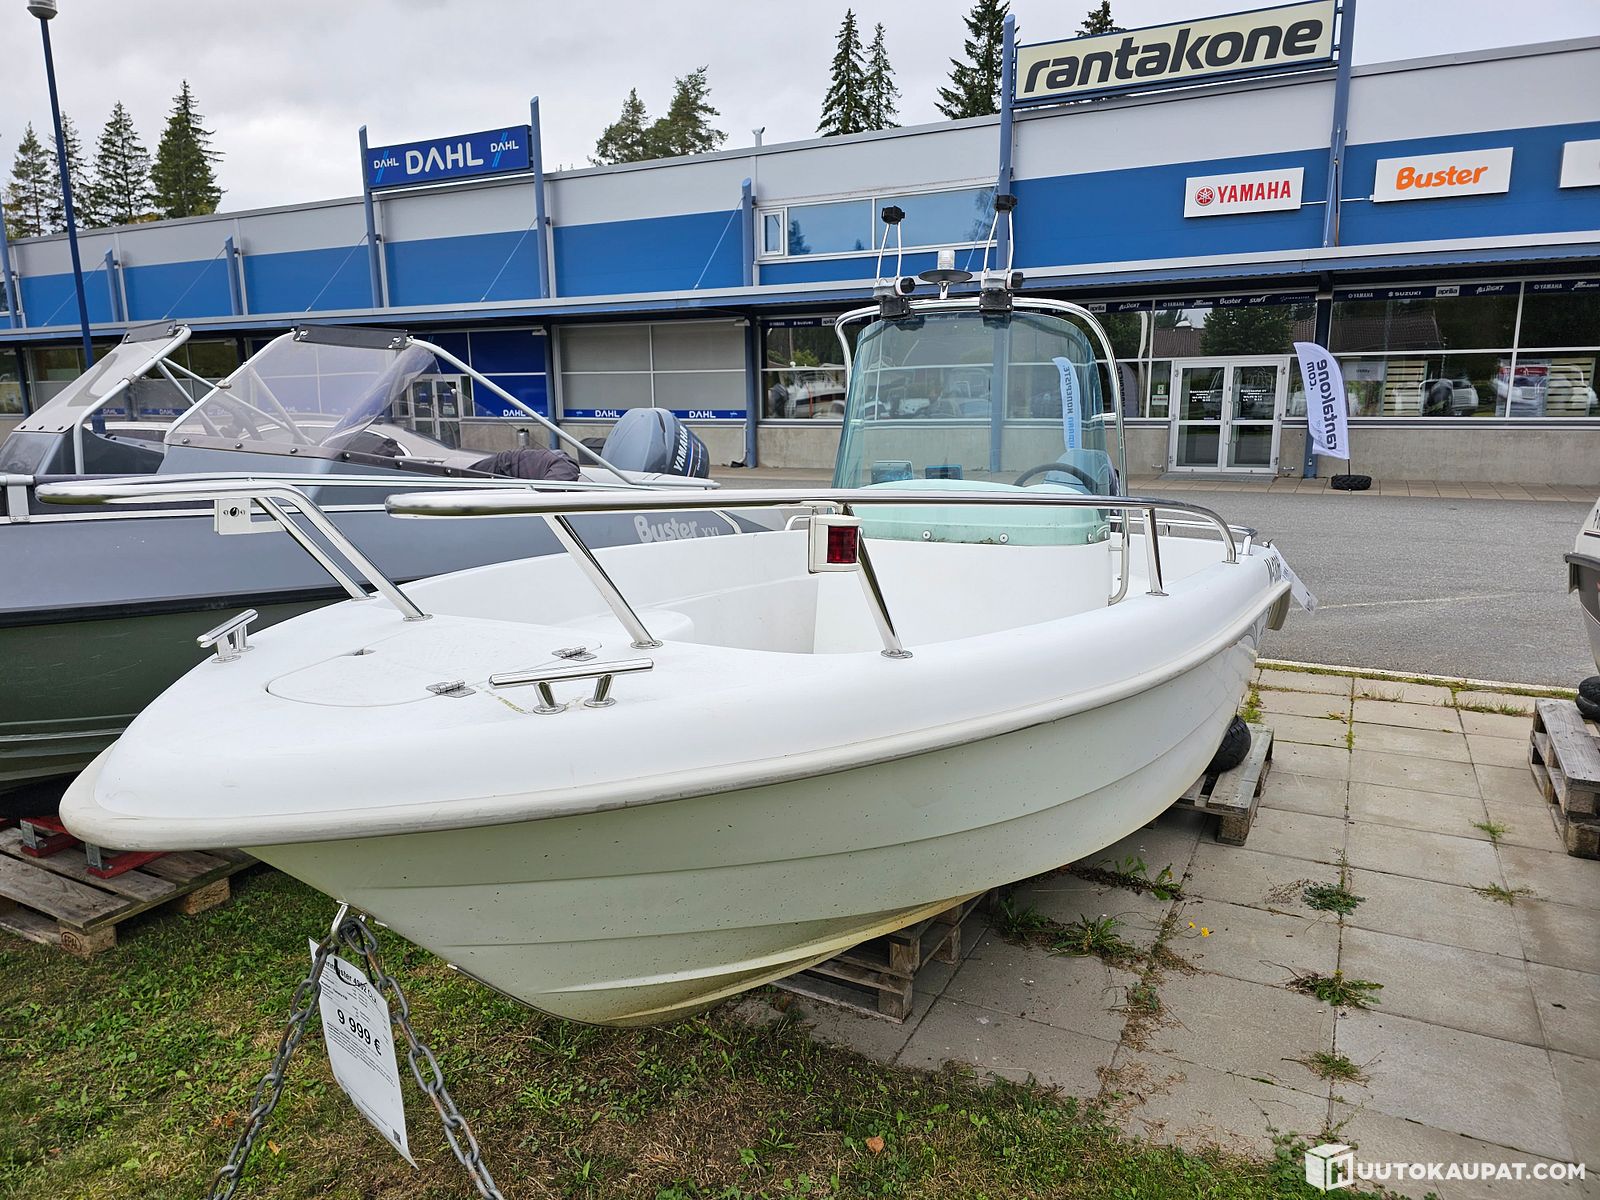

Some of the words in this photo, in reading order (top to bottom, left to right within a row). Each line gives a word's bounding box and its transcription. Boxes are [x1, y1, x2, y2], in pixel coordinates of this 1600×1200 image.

[1023, 18, 1324, 94] rantakone
[405, 141, 484, 175] DAHL
[490, 140, 519, 153] DAHL
[374, 157, 399, 169] DAHL
[1396, 165, 1489, 191] Buster
[1218, 179, 1292, 203] YAMAHA
[503, 409, 527, 417] DAHL
[595, 409, 620, 418] DAHL
[688, 410, 716, 418] DAHL
[673, 425, 688, 472] YAMAHA
[633, 515, 698, 543] Buster
[337, 1008, 346, 1025] 9
[348, 1017, 371, 1045] 999
[373, 1039, 382, 1056] €
